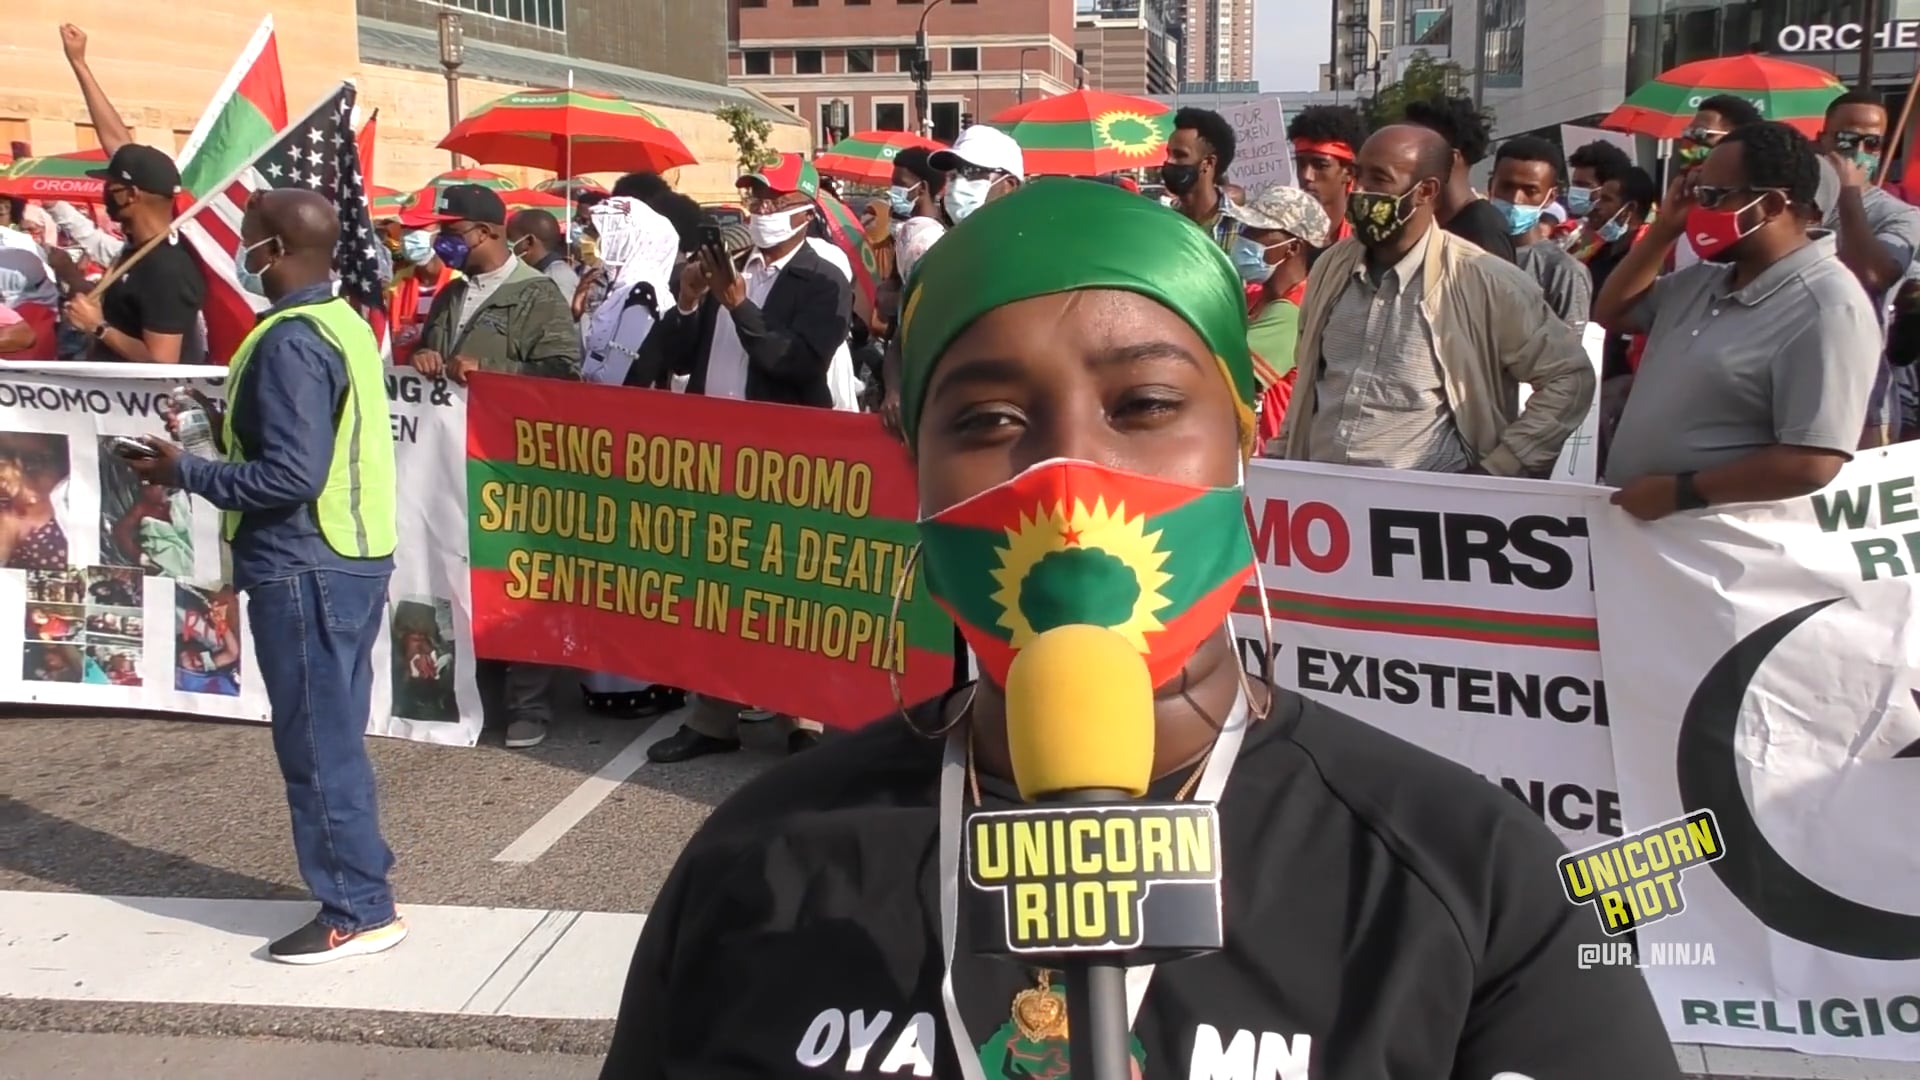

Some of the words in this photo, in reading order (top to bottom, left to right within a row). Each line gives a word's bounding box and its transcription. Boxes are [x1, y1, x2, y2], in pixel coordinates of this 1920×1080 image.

[1233, 108, 1263, 128] OUR
[33, 179, 104, 193] OROMIA
[1231, 159, 1284, 178] VIOLENT
[0, 384, 111, 414] OROMO
[514, 419, 613, 479] BEING
[625, 432, 722, 495] BORN
[735, 446, 872, 519] OROMO
[1244, 496, 1350, 574] MO
[1810, 476, 1920, 533] WE
[480, 481, 617, 544] SHOULD
[629, 500, 697, 558] NOT
[706, 512, 752, 570] BE
[761, 523, 783, 577] A
[796, 528, 917, 602] DEATH
[505, 550, 685, 625] SENTENCE
[694, 578, 731, 634] IN
[740, 588, 906, 675] ETHIOPIA
[1500, 776, 1623, 837] NCE
[976, 816, 1212, 880] UNICORN
[1015, 880, 1138, 940] RIOT
[796, 1007, 936, 1077] OYA
[1188, 1023, 1312, 1080] MN
